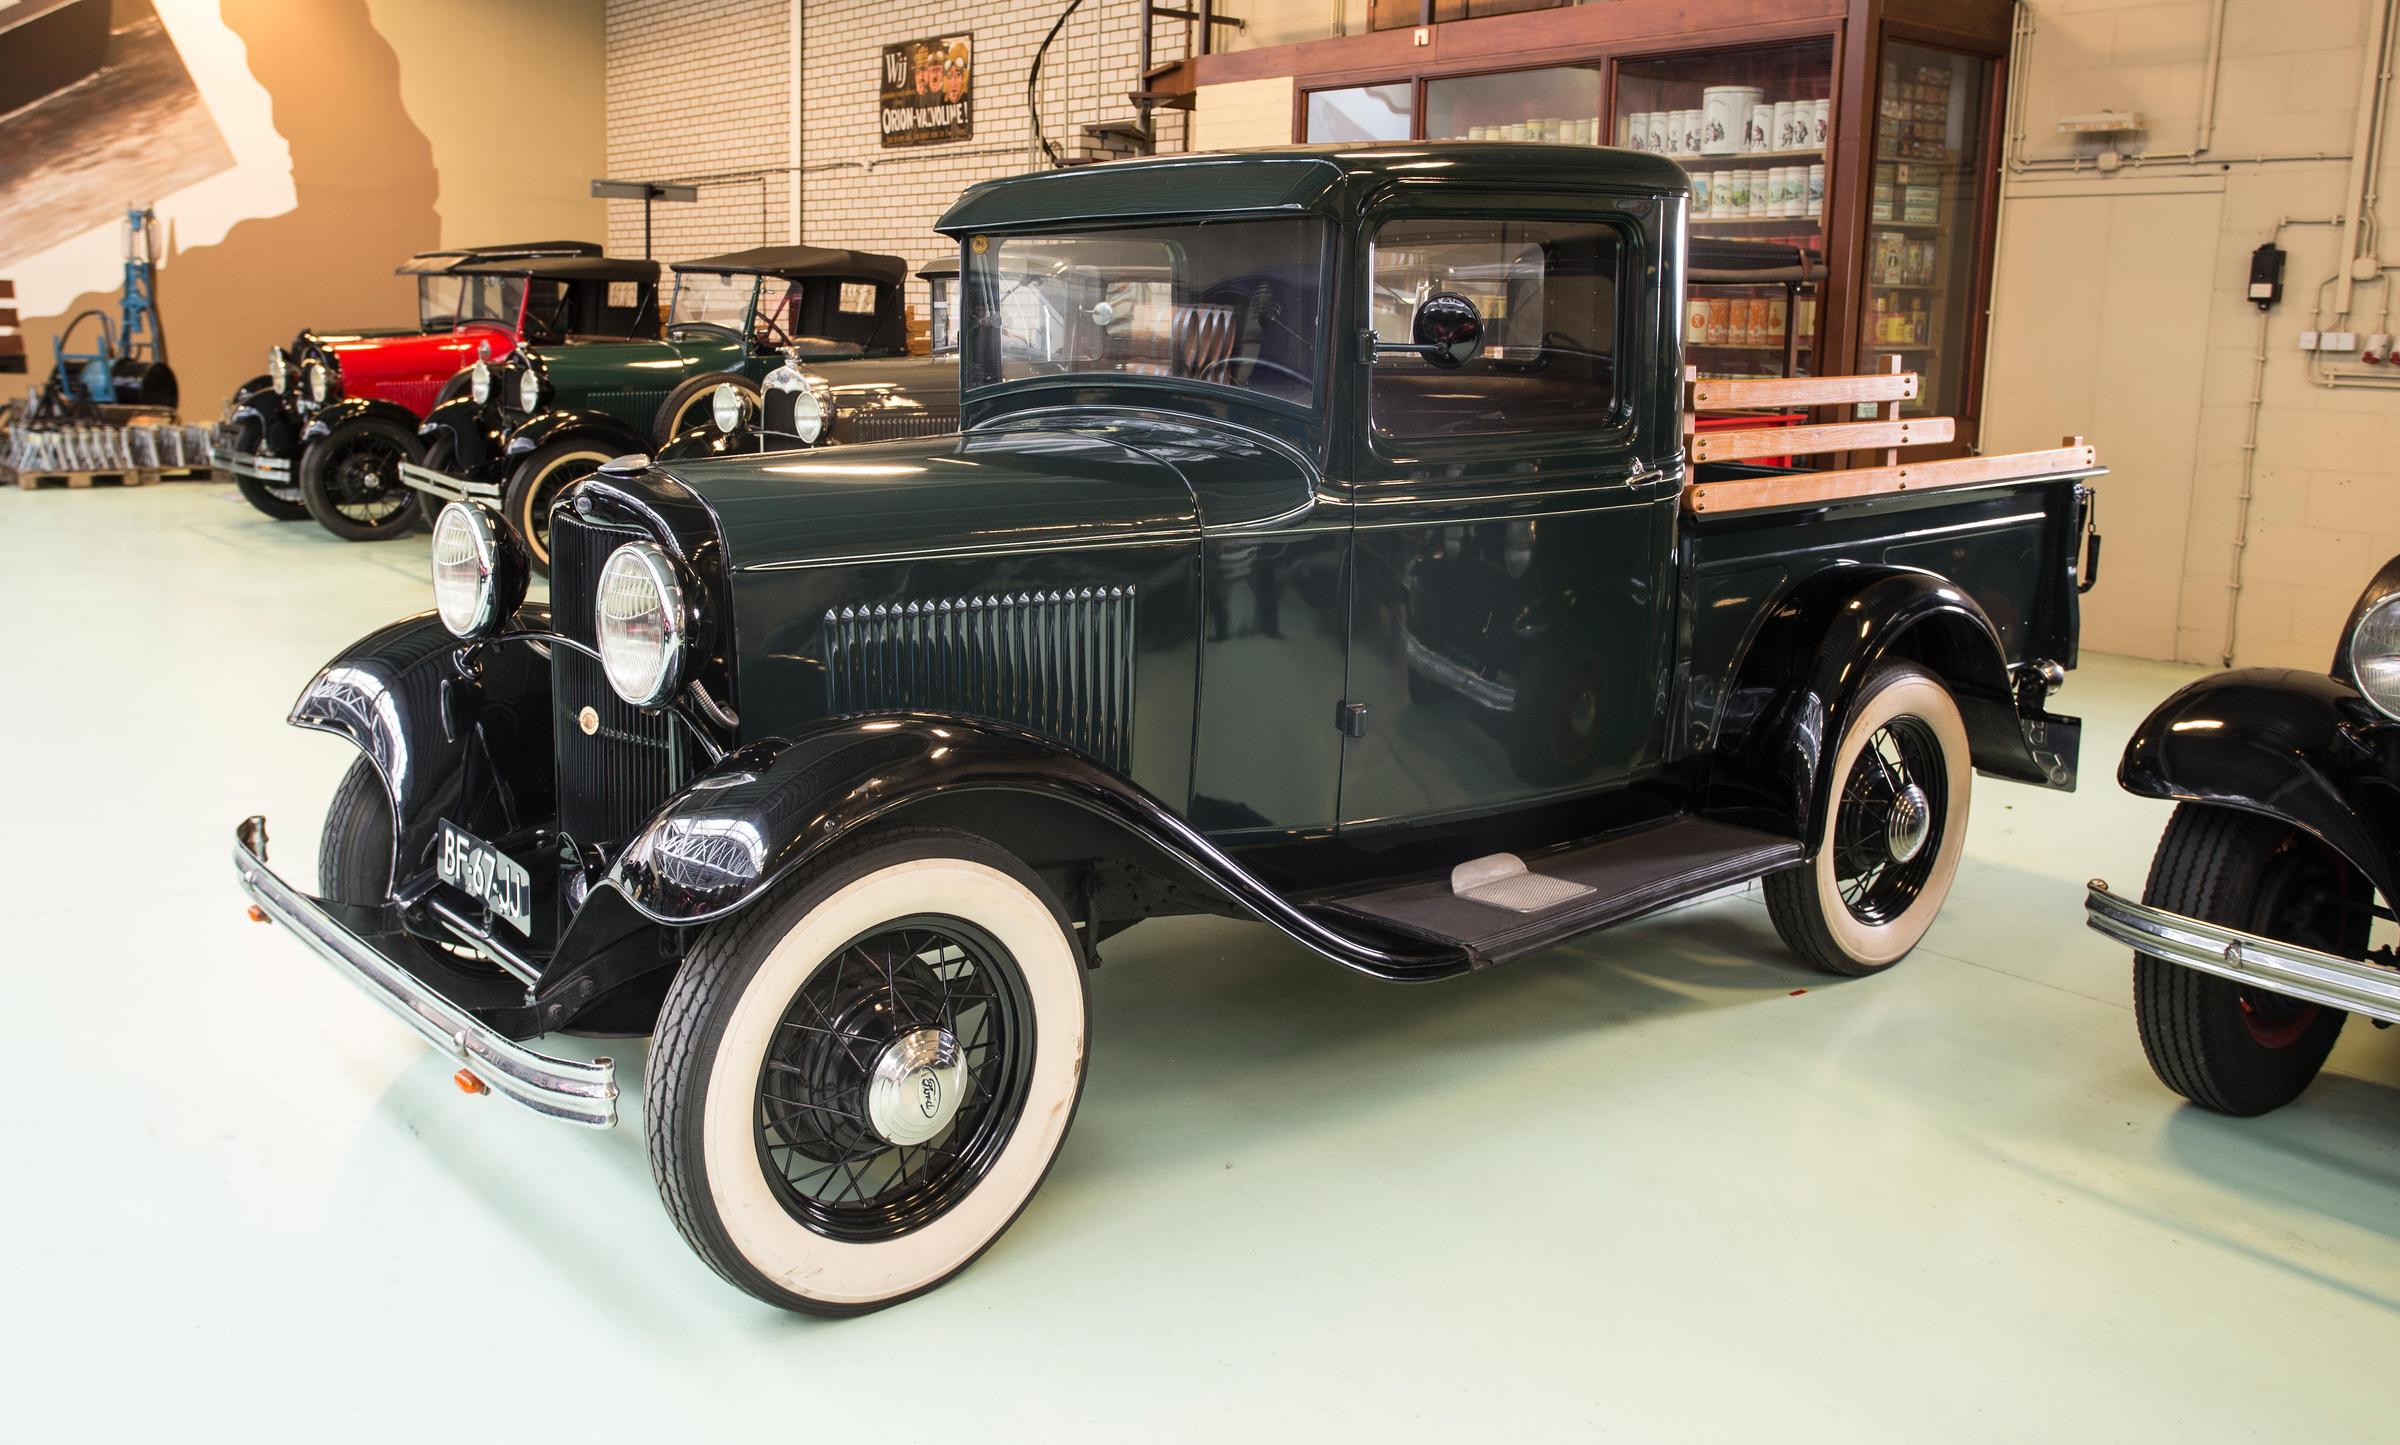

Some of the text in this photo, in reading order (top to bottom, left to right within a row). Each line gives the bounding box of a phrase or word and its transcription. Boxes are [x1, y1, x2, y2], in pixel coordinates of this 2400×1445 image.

[885, 52, 908, 88] Wij
[444, 828, 521, 918] BF-67-JJ
[921, 1077, 936, 1110] Ford
